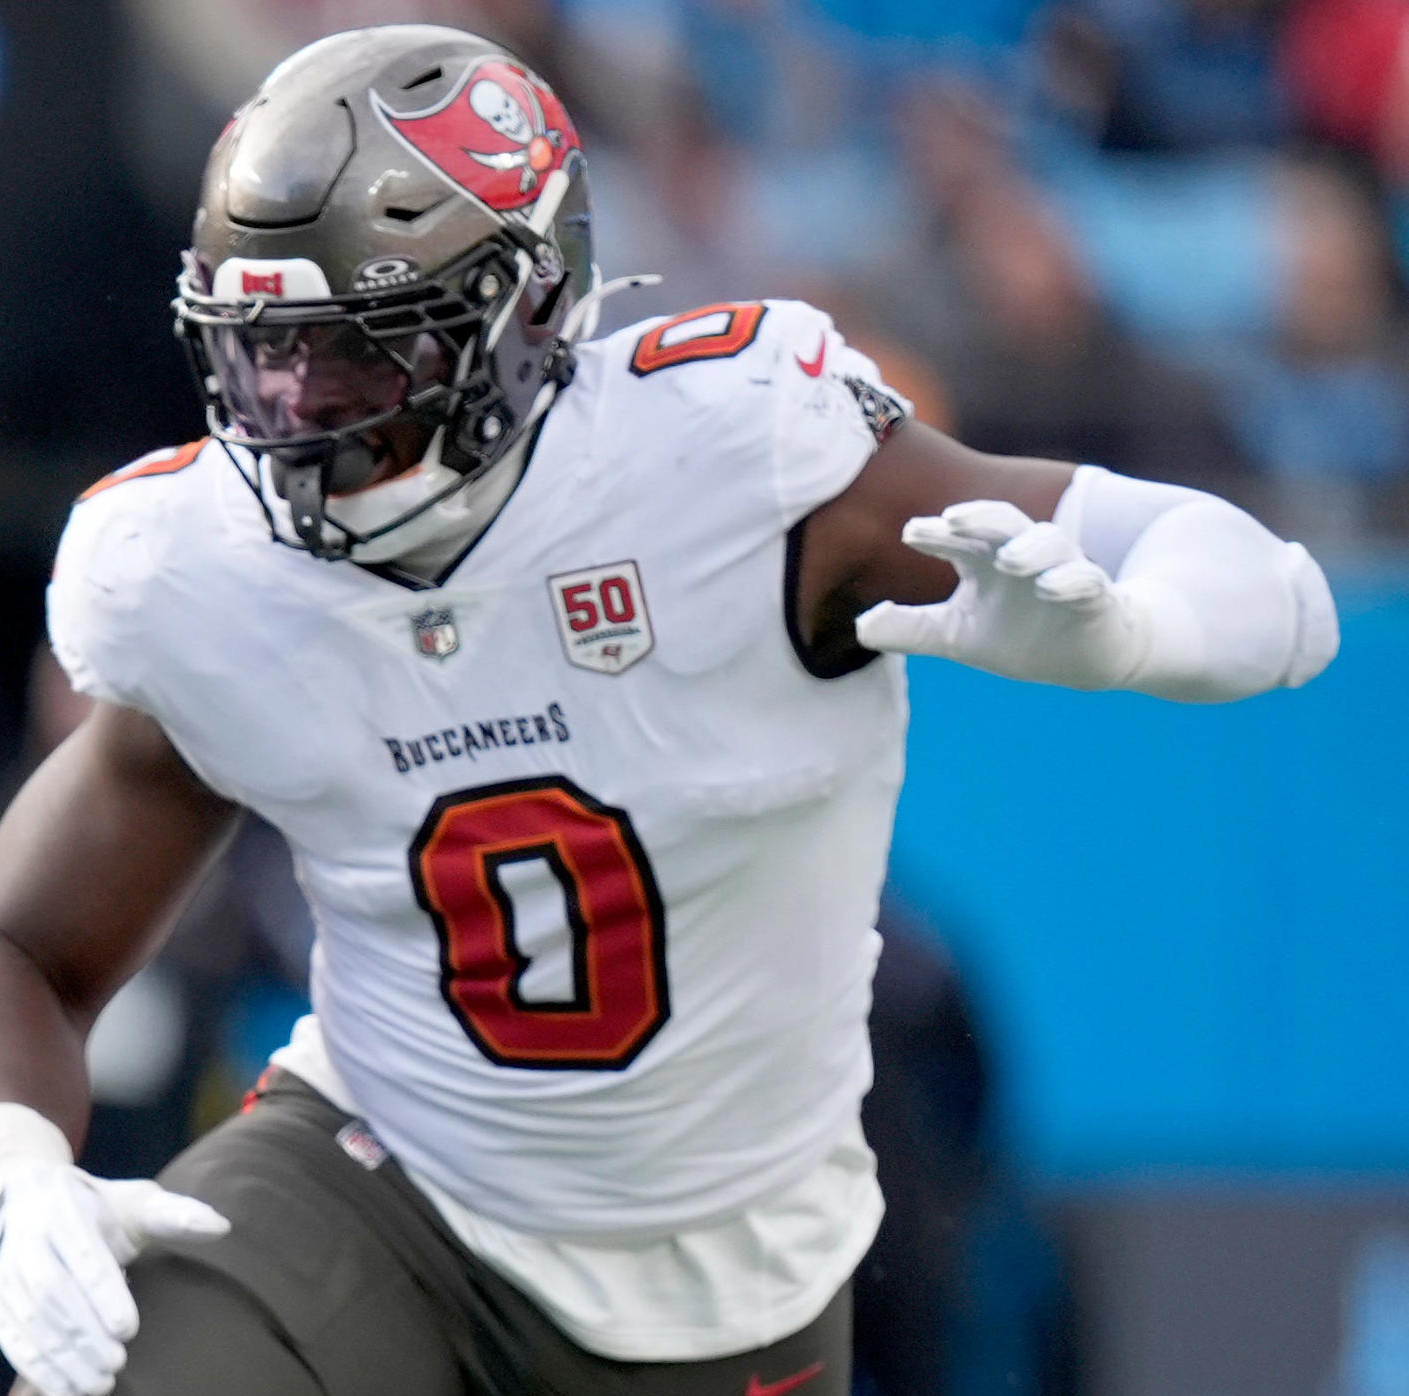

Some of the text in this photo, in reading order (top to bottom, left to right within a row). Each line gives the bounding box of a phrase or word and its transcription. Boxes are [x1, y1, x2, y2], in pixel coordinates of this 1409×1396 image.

[561, 576, 636, 633] 50
[382, 701, 571, 774] BUCCANEERS
[408, 773, 672, 1071] 0
